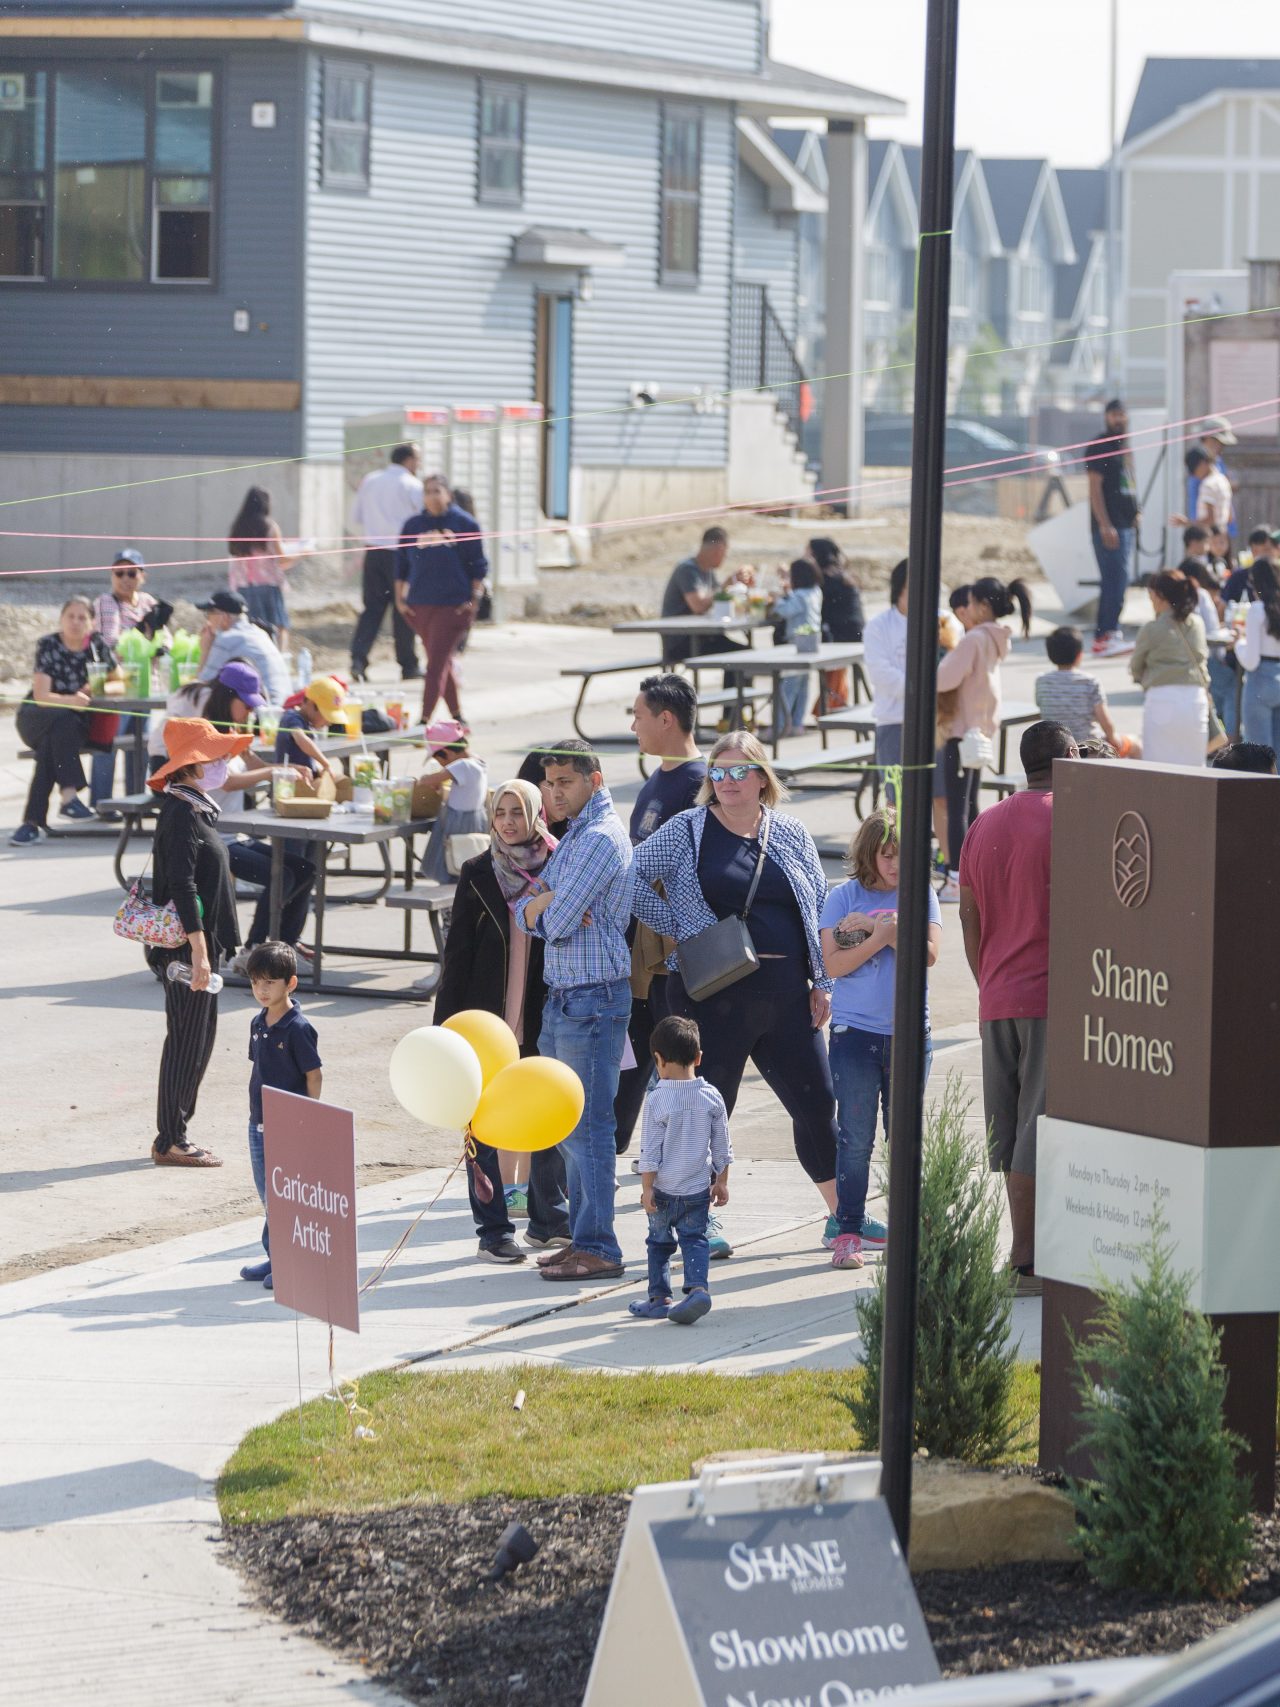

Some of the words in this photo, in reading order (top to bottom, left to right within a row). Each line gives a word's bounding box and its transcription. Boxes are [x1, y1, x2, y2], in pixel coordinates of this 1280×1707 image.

[1091, 948, 1169, 1007] Shane
[1083, 1014, 1173, 1076] Homes
[272, 1166, 349, 1219] Caricature
[1067, 1162, 1093, 1186] Monday
[1095, 1171, 1101, 1184] to
[1102, 1168, 1131, 1193] Thursday
[1134, 1174, 1139, 1192] 2
[1140, 1181, 1150, 1196] pm
[292, 1215, 332, 1257] Artist
[1065, 1196, 1095, 1218] Weekends
[1096, 1202, 1102, 1219] &
[1103, 1203, 1130, 1228] Holidays
[1133, 1208, 1140, 1227] 12
[709, 1620, 909, 1672] Showhome
